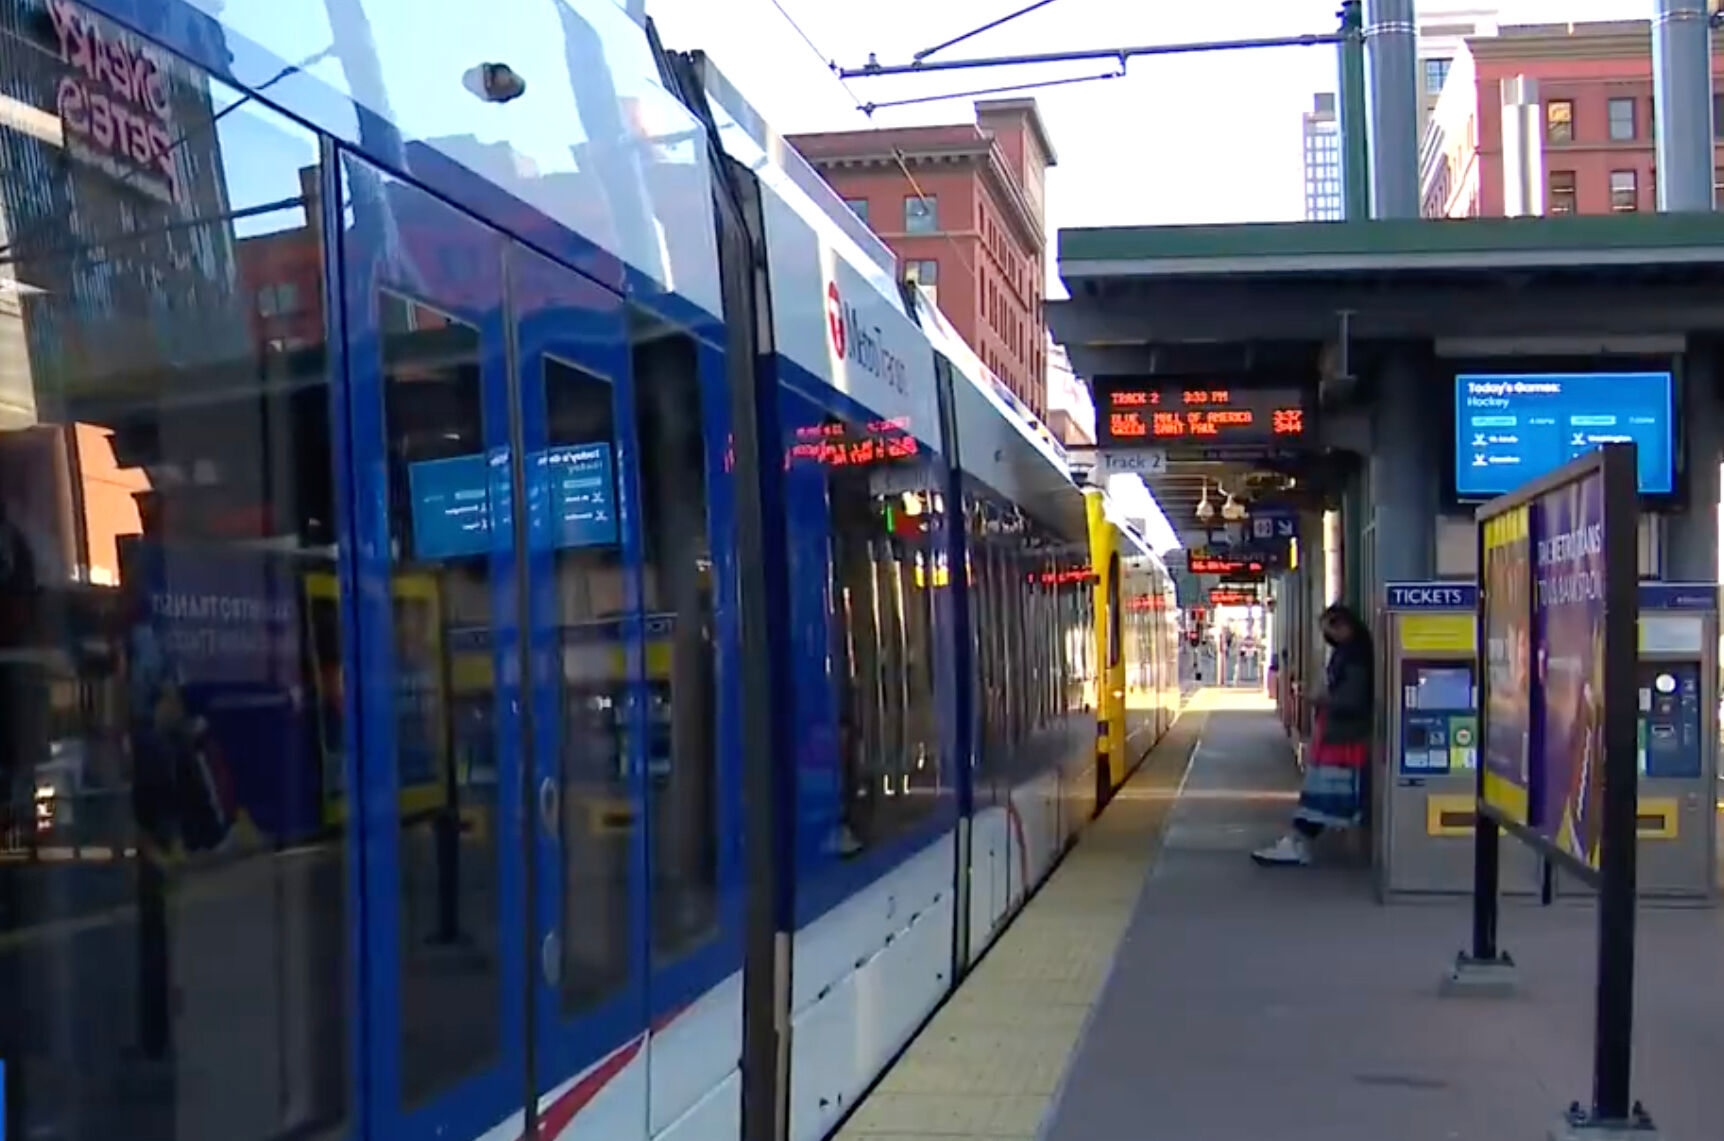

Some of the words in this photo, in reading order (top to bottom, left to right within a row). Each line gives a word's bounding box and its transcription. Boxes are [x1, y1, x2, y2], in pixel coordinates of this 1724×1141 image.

[1467, 382, 1512, 395] Today's
[1514, 382, 1561, 393] Games:
[1111, 392, 1146, 405] TRACK
[1149, 392, 1160, 404] 2
[1211, 391, 1229, 404] PM
[1467, 397, 1510, 408] Hockey
[1104, 455, 1146, 469] Track
[1153, 455, 1161, 468] 2
[1393, 588, 1462, 604] TICKETS
